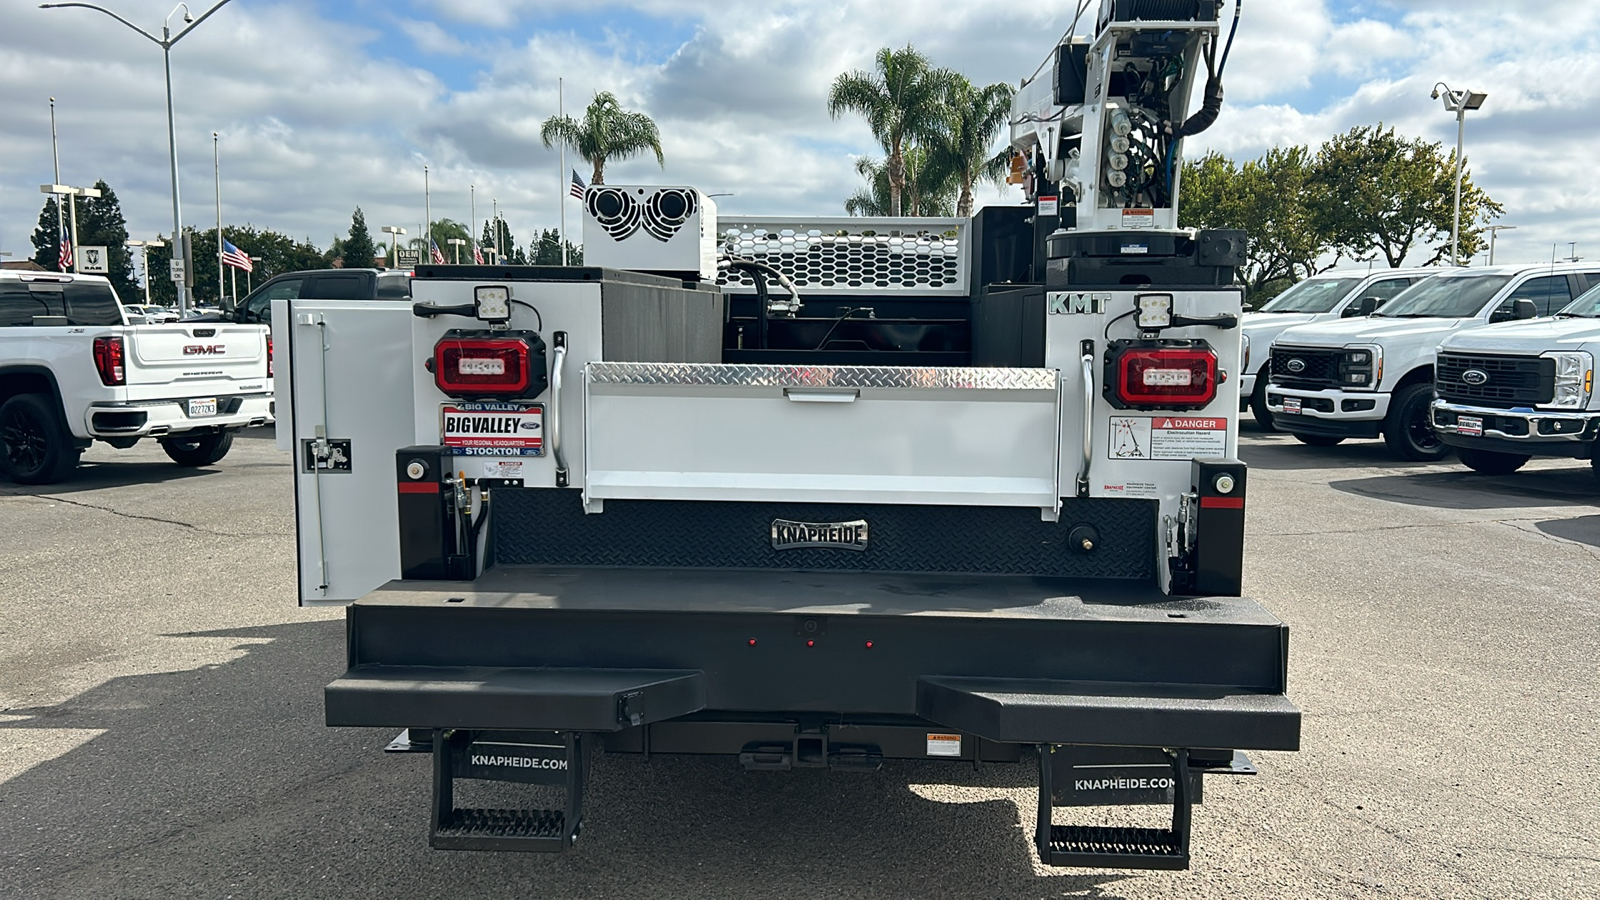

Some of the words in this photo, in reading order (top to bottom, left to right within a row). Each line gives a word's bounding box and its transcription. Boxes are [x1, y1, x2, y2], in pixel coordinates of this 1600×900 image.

[399, 250, 419, 258] OEM
[1049, 293, 1112, 315] KMT
[183, 345, 226, 355] GMC
[190, 404, 216, 415] 02272K3
[485, 403, 519, 411] VALLEY
[446, 417, 521, 433] BIGVALLEY
[1175, 420, 1216, 428] DANGER
[465, 447, 521, 455] STOCKTON
[776, 524, 863, 546] KNAPHEIDE
[471, 755, 568, 770] KNAPHEIDE.COM
